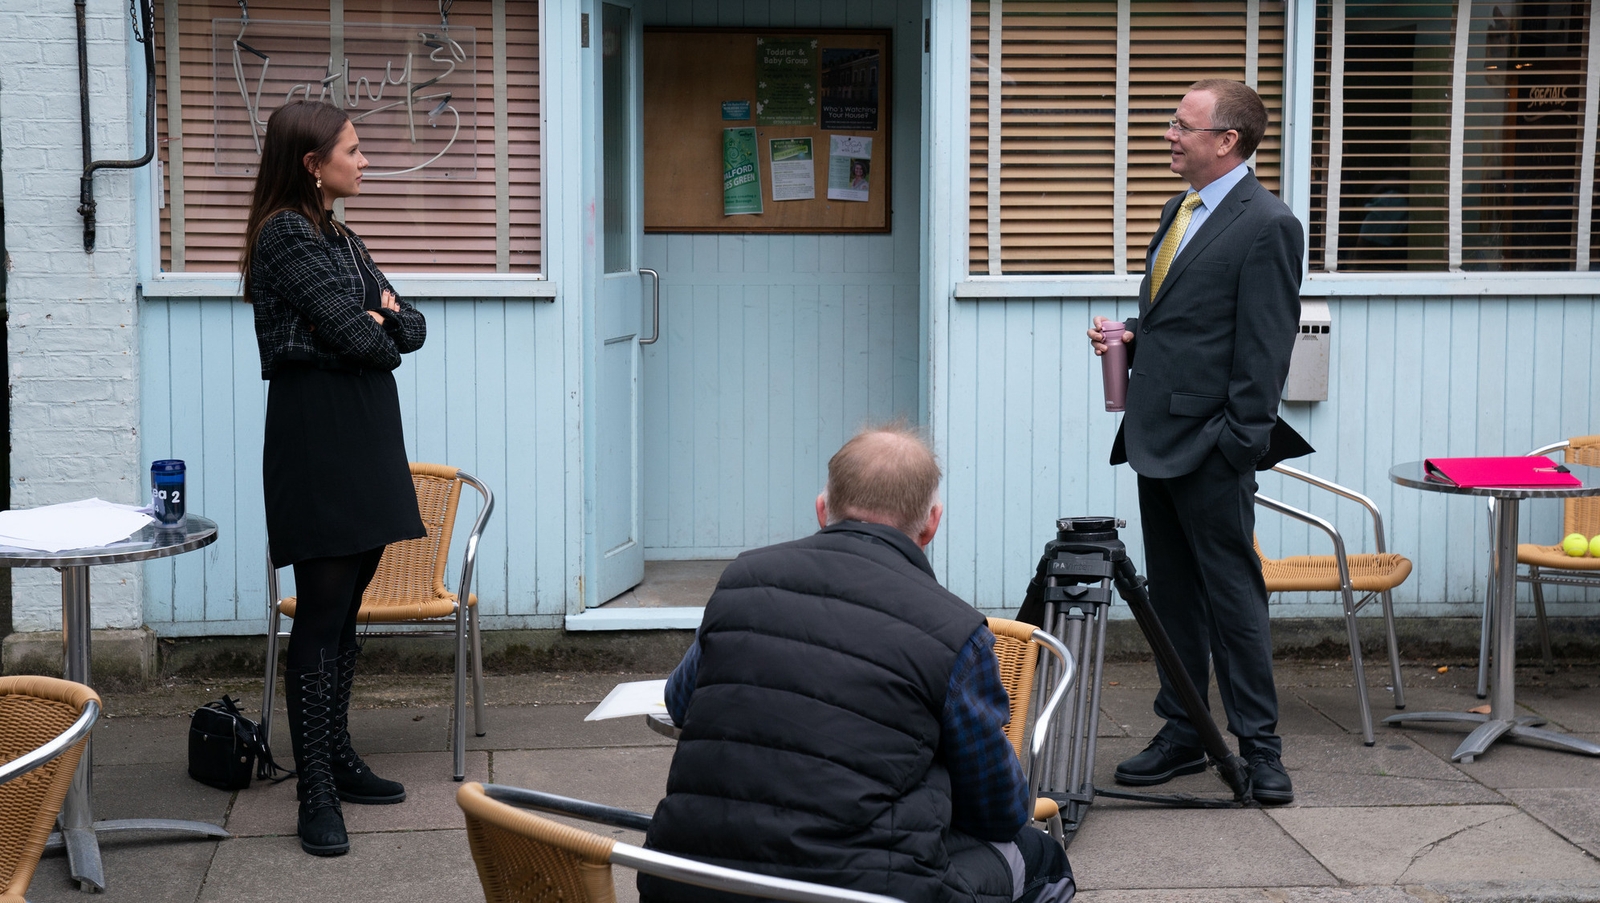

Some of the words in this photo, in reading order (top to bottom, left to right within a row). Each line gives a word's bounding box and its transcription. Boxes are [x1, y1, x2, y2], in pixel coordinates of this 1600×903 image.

[765, 48, 796, 56] Toddler
[798, 48, 805, 56] &
[763, 57, 782, 66] Baby
[785, 57, 808, 66] Group
[1528, 87, 1567, 108] SPECIALS
[844, 106, 877, 115] Watching
[840, 139, 863, 148] YOGA
[724, 164, 753, 181] ALFORD
[733, 173, 756, 186] GREEN
[153, 488, 167, 500] ea
[171, 491, 180, 503] 2
